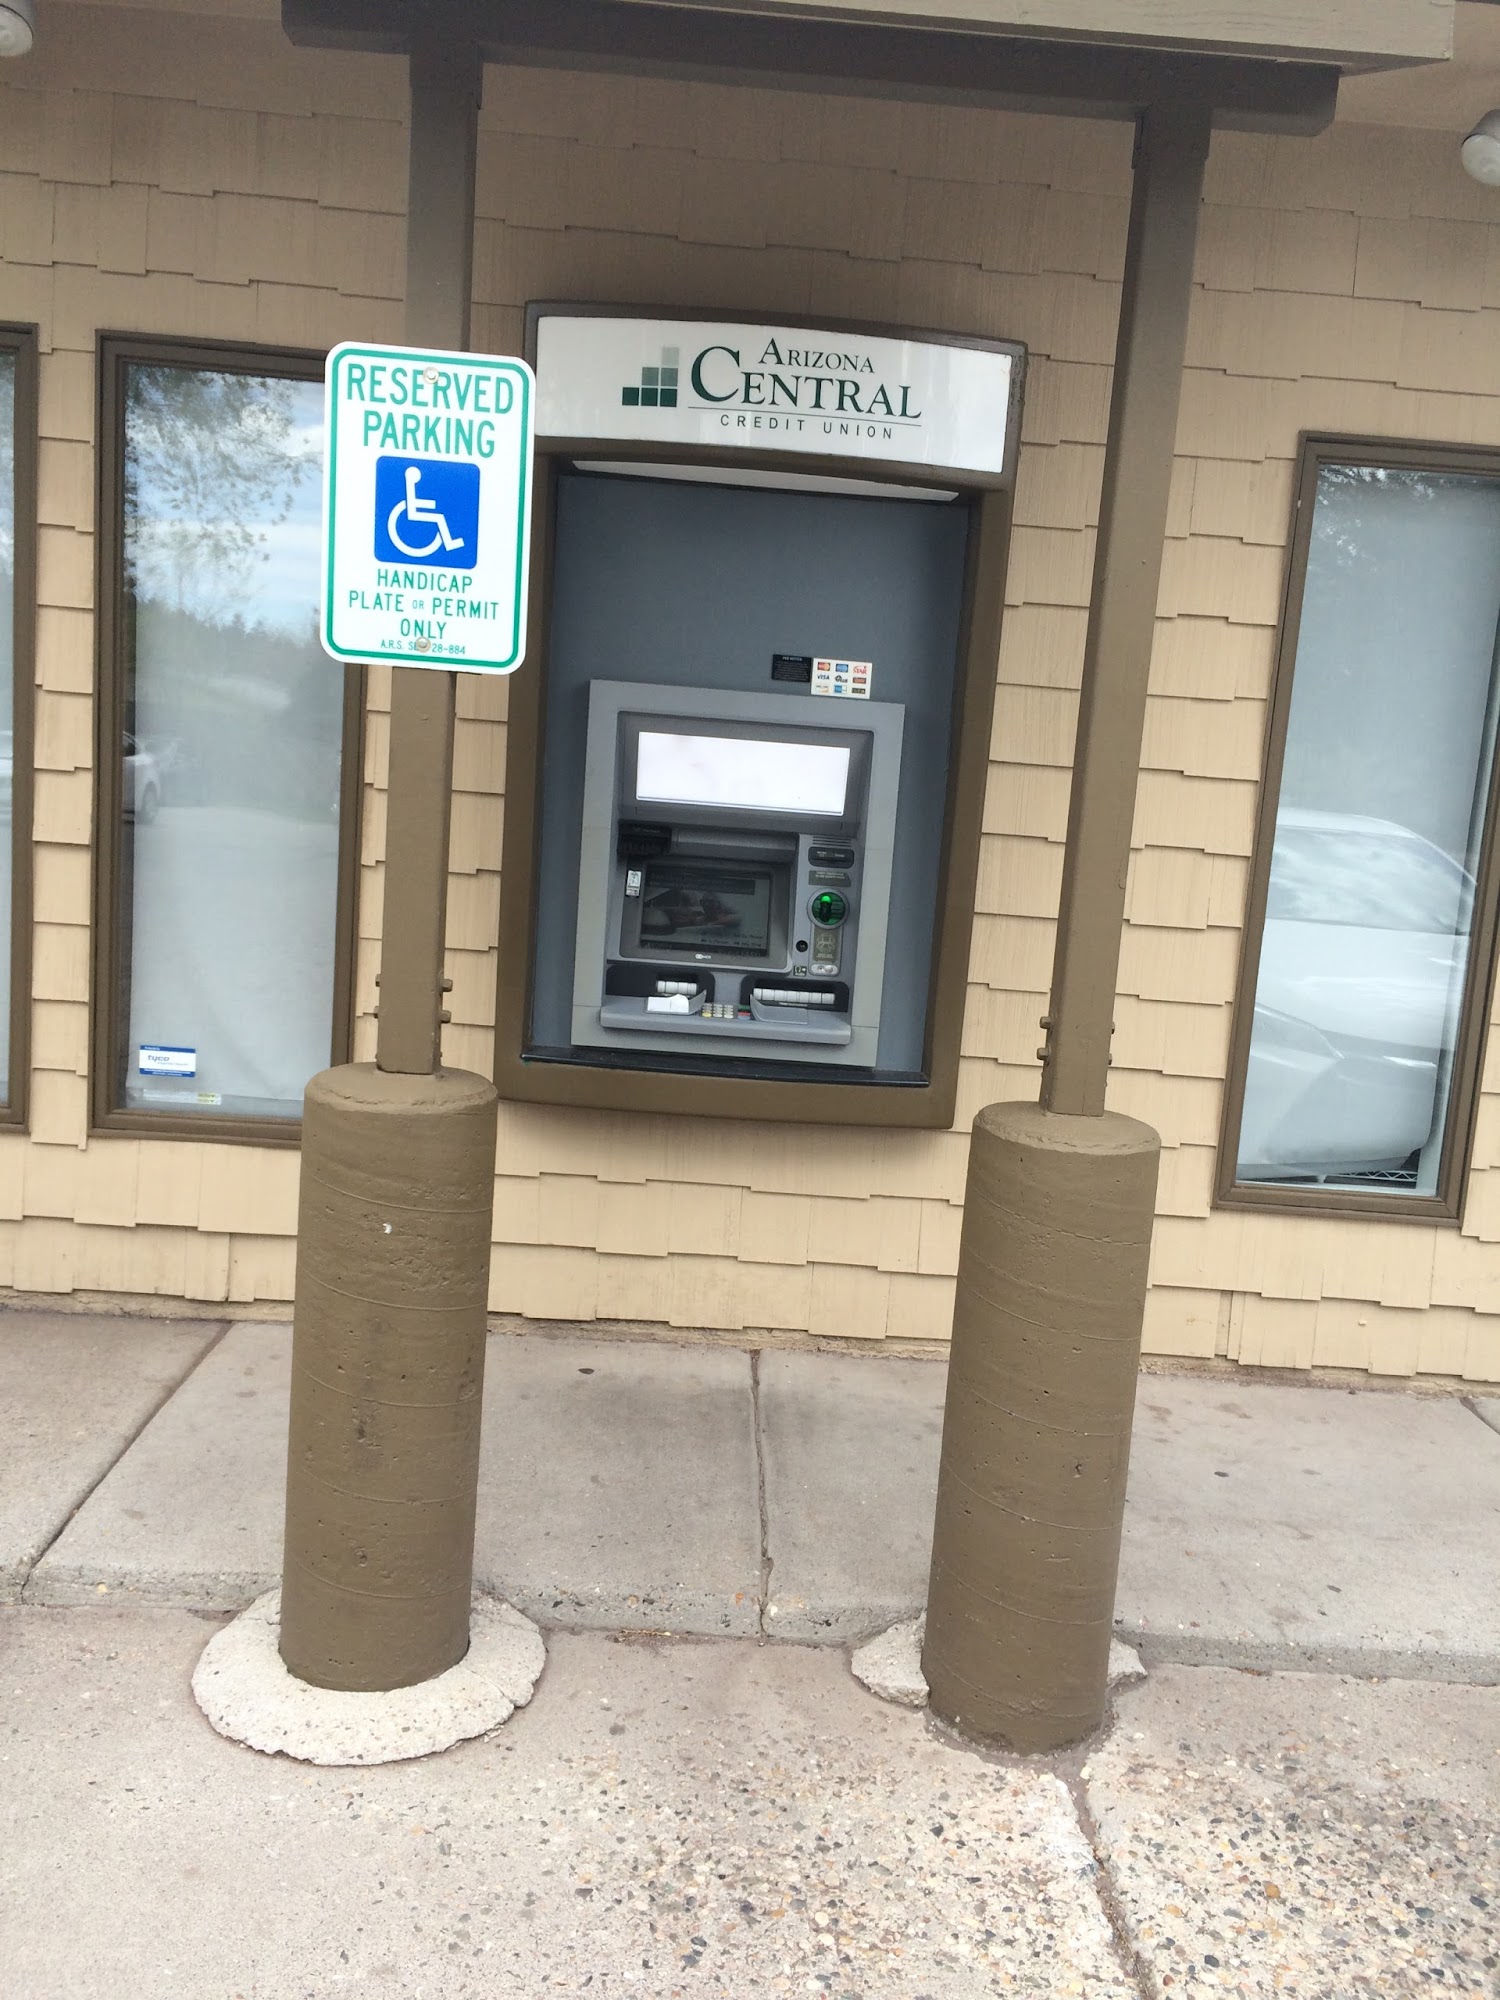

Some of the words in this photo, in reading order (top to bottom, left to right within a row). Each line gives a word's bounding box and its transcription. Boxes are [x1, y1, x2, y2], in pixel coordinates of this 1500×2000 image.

[758, 337, 875, 373] ARIZONA
[347, 363, 514, 415] RESERVED
[691, 346, 922, 419] CENTRAL
[363, 410, 495, 459] PARKING
[720, 414, 805, 431] CREDIT
[823, 421, 893, 440] UNION
[377, 569, 473, 594] HANDICAP
[349, 590, 404, 612] PLATE
[432, 597, 499, 620] PERMIT
[400, 618, 447, 640] ONLY
[147, 1054, 170, 1062] tyco
